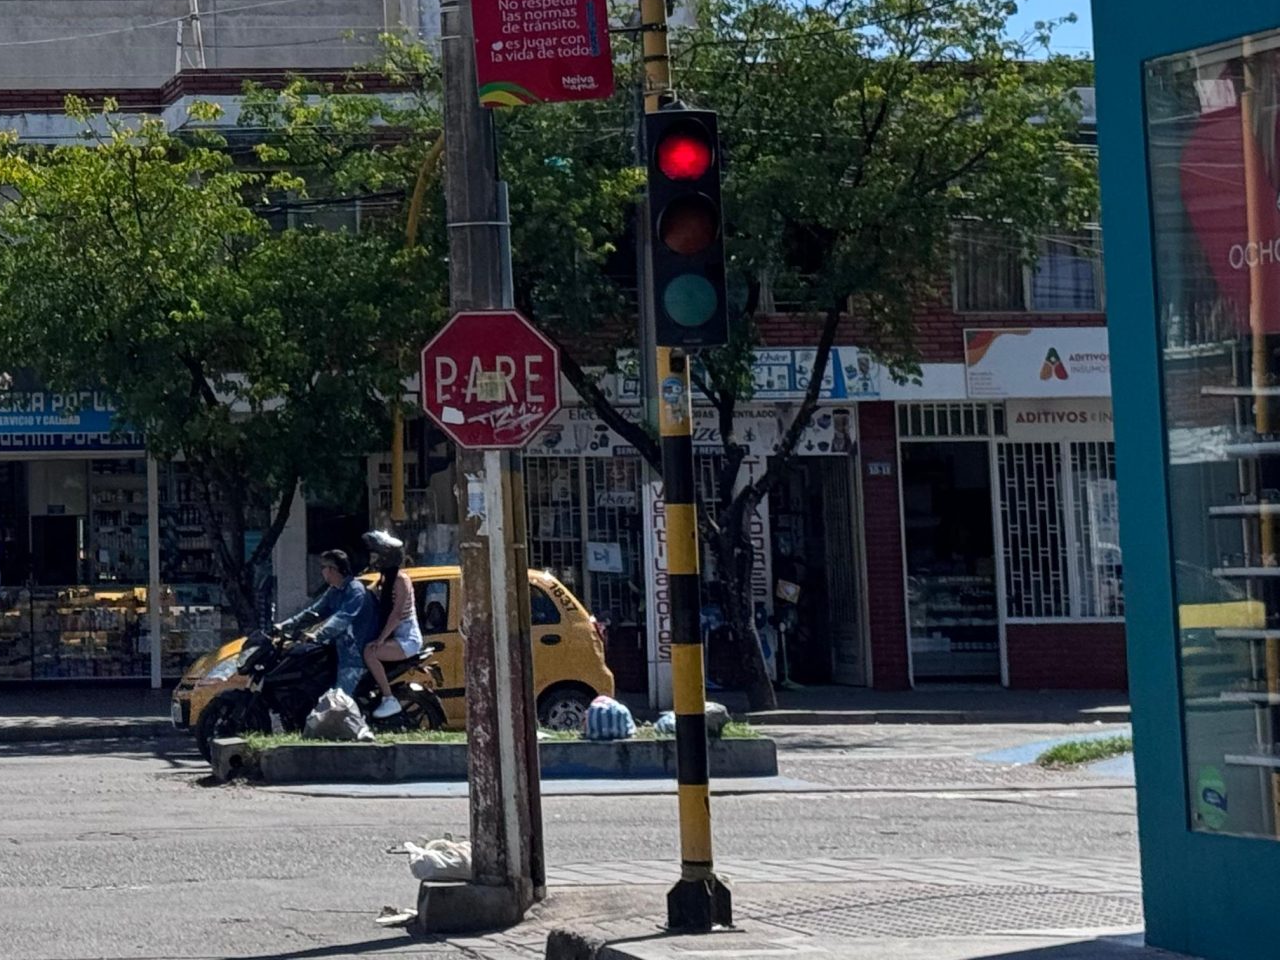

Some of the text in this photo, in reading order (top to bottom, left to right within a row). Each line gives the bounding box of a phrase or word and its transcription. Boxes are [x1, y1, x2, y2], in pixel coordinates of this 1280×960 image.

[498, 0, 518, 11] No
[502, 8, 577, 22] las normas
[502, 22, 520, 34] de
[505, 35, 585, 53] es jugar con
[490, 51, 502, 62] la
[505, 48, 534, 61] vida
[537, 46, 554, 59] de
[562, 75, 594, 85] Neiva
[435, 355, 545, 404] PARE
[732, 410, 775, 418] ENTILADO
[1016, 411, 1088, 424] ADITIVOS
[35, 416, 42, 426] Y
[549, 581, 579, 611] 1837
